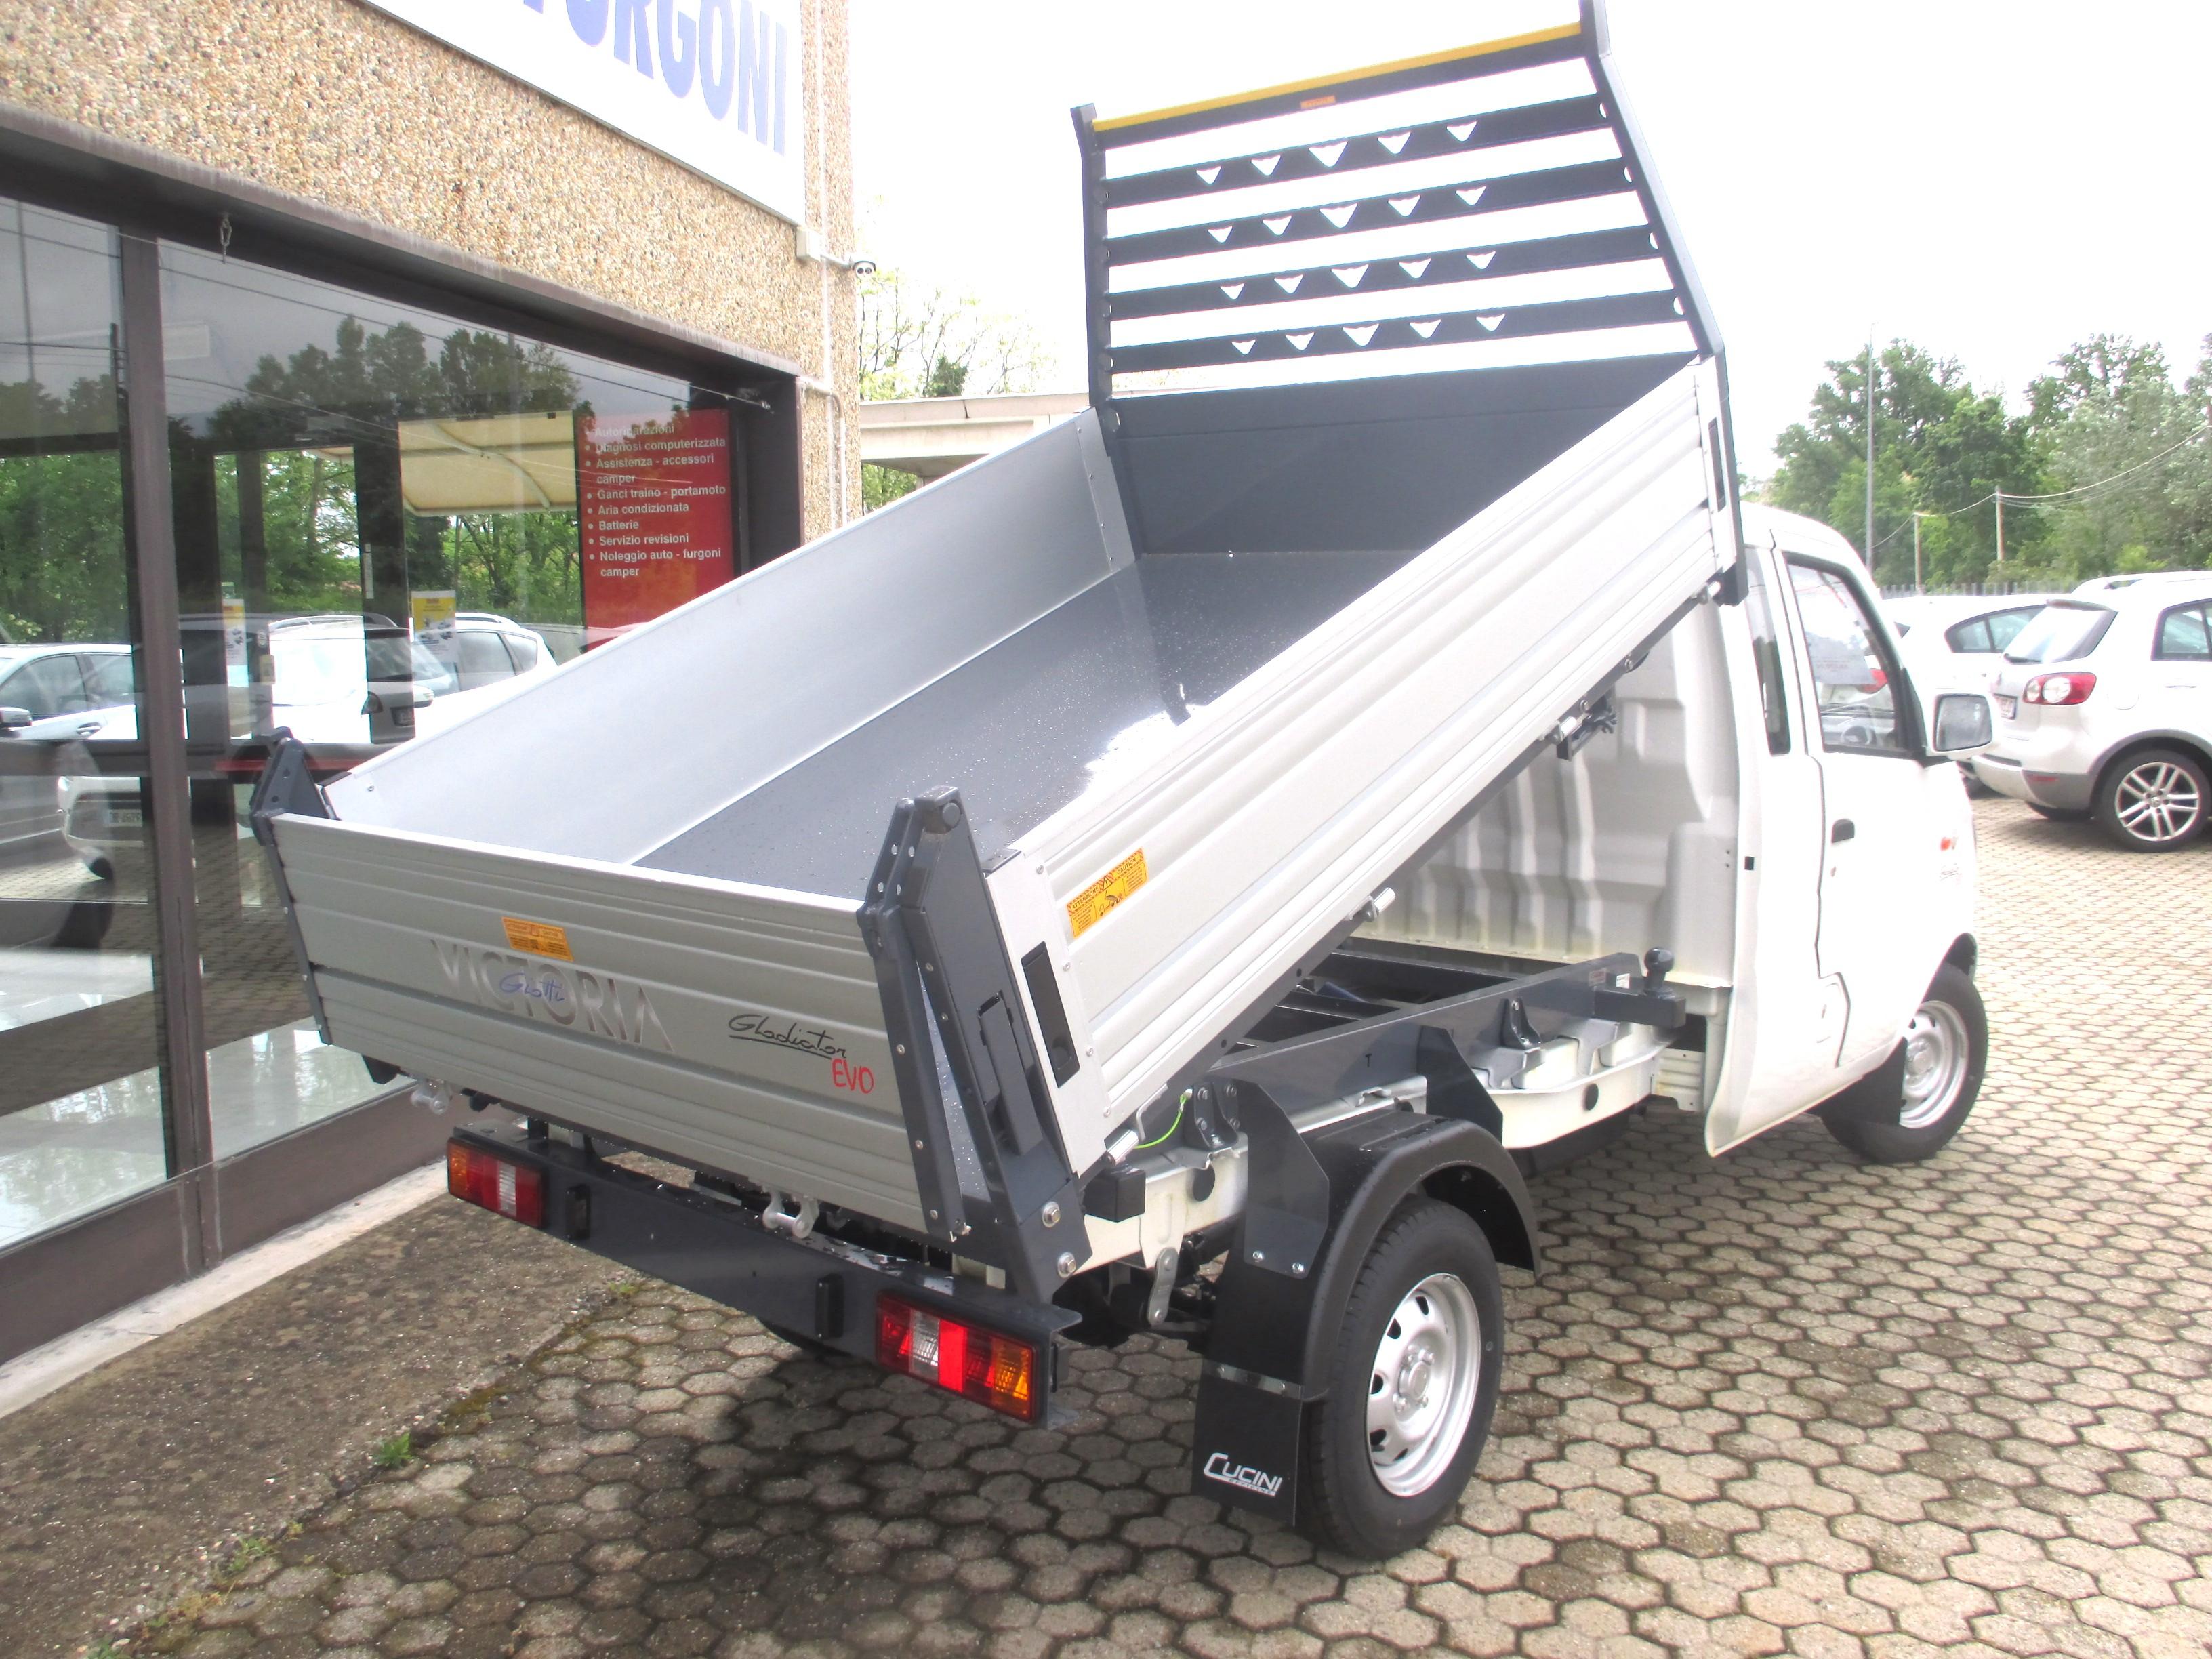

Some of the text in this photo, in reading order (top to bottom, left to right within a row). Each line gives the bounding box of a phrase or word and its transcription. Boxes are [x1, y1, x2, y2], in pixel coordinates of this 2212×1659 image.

[523, 0, 787, 157] RGONI
[595, 425, 675, 438] Autoriparazioni
[596, 437, 726, 455] Diagnosi computerizzata
[596, 458, 653, 469] Assistenza
[663, 453, 714, 466] accessori
[596, 475, 635, 486] camper
[598, 489, 628, 499] Ganci
[630, 487, 661, 498] traino
[671, 485, 726, 498] portamoto
[598, 503, 689, 516] Aria condizionata
[599, 520, 640, 531] Batterie
[599, 533, 689, 546] Servizio revisioni
[600, 550, 647, 563] Noleggio
[650, 551, 673, 560] auto
[683, 548, 721, 562] furgoni
[600, 567, 640, 579] camper
[1117, 857, 1137, 875] CAUTION
[1071, 886, 1100, 910] ATTENZIONE
[430, 939, 674, 1052] VICTORIA
[729, 1014, 846, 1059] Gladiator
[832, 1058, 874, 1094] EVO
